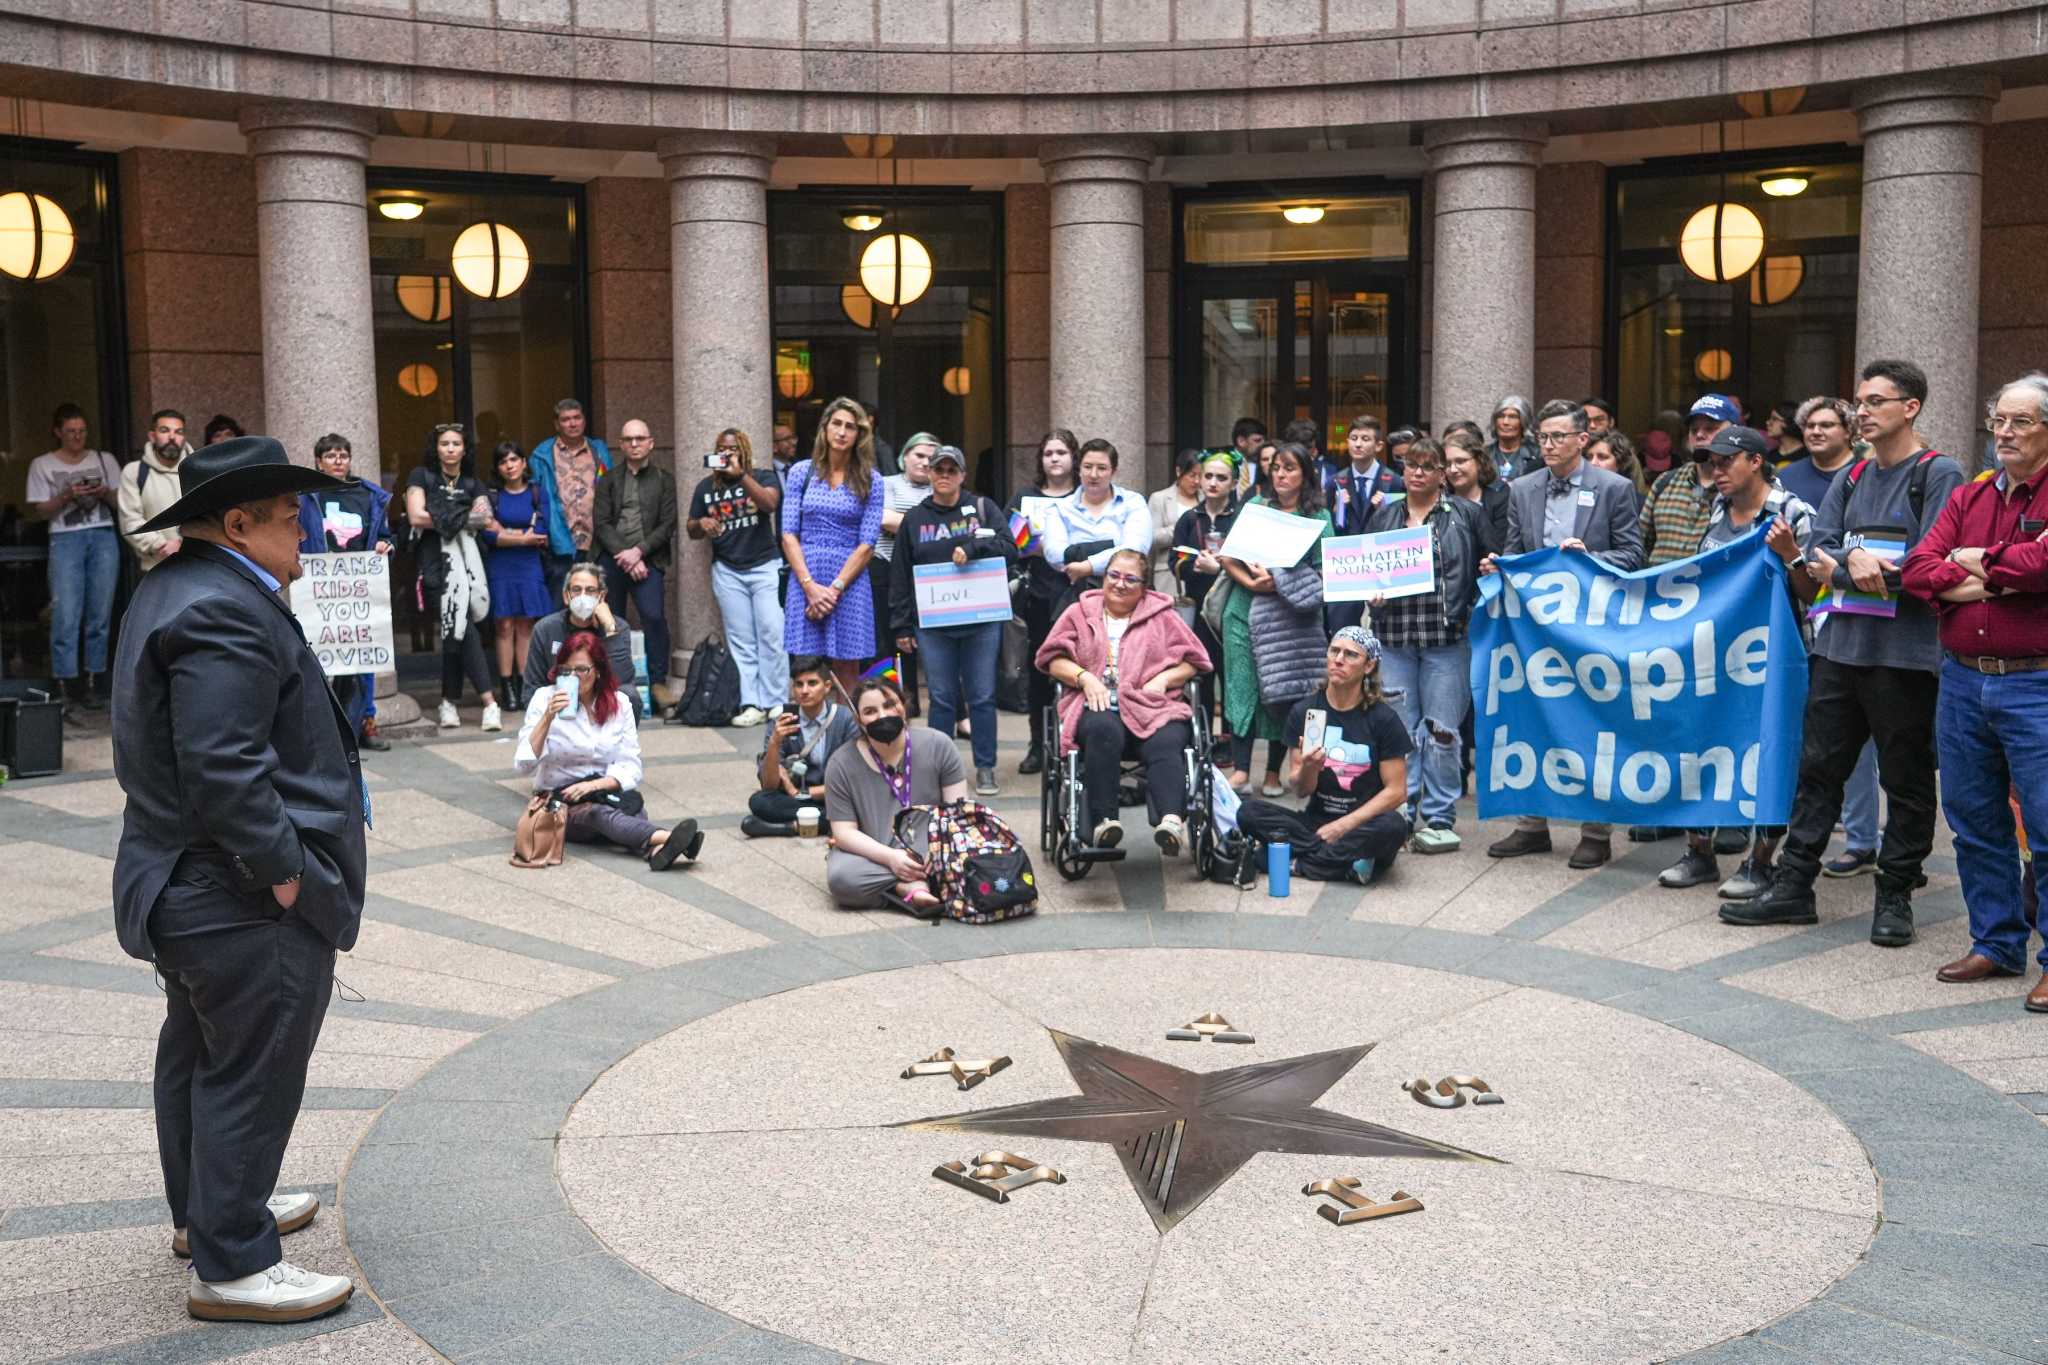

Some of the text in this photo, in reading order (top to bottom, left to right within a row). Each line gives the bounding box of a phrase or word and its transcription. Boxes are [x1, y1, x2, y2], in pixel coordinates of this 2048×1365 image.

[704, 487, 744, 504] BLAC
[719, 515, 759, 535] TTER
[920, 517, 981, 542] MAMA
[1332, 544, 1423, 565] NO HATE IN
[300, 555, 384, 577] TRANS
[1336, 558, 1420, 576] OUR STATE
[313, 579, 369, 600] KIDS
[1487, 563, 1702, 626] rans
[317, 601, 370, 622] YOU
[319, 624, 373, 645] ARE
[317, 647, 389, 668] OVED
[1485, 619, 1769, 720] people
